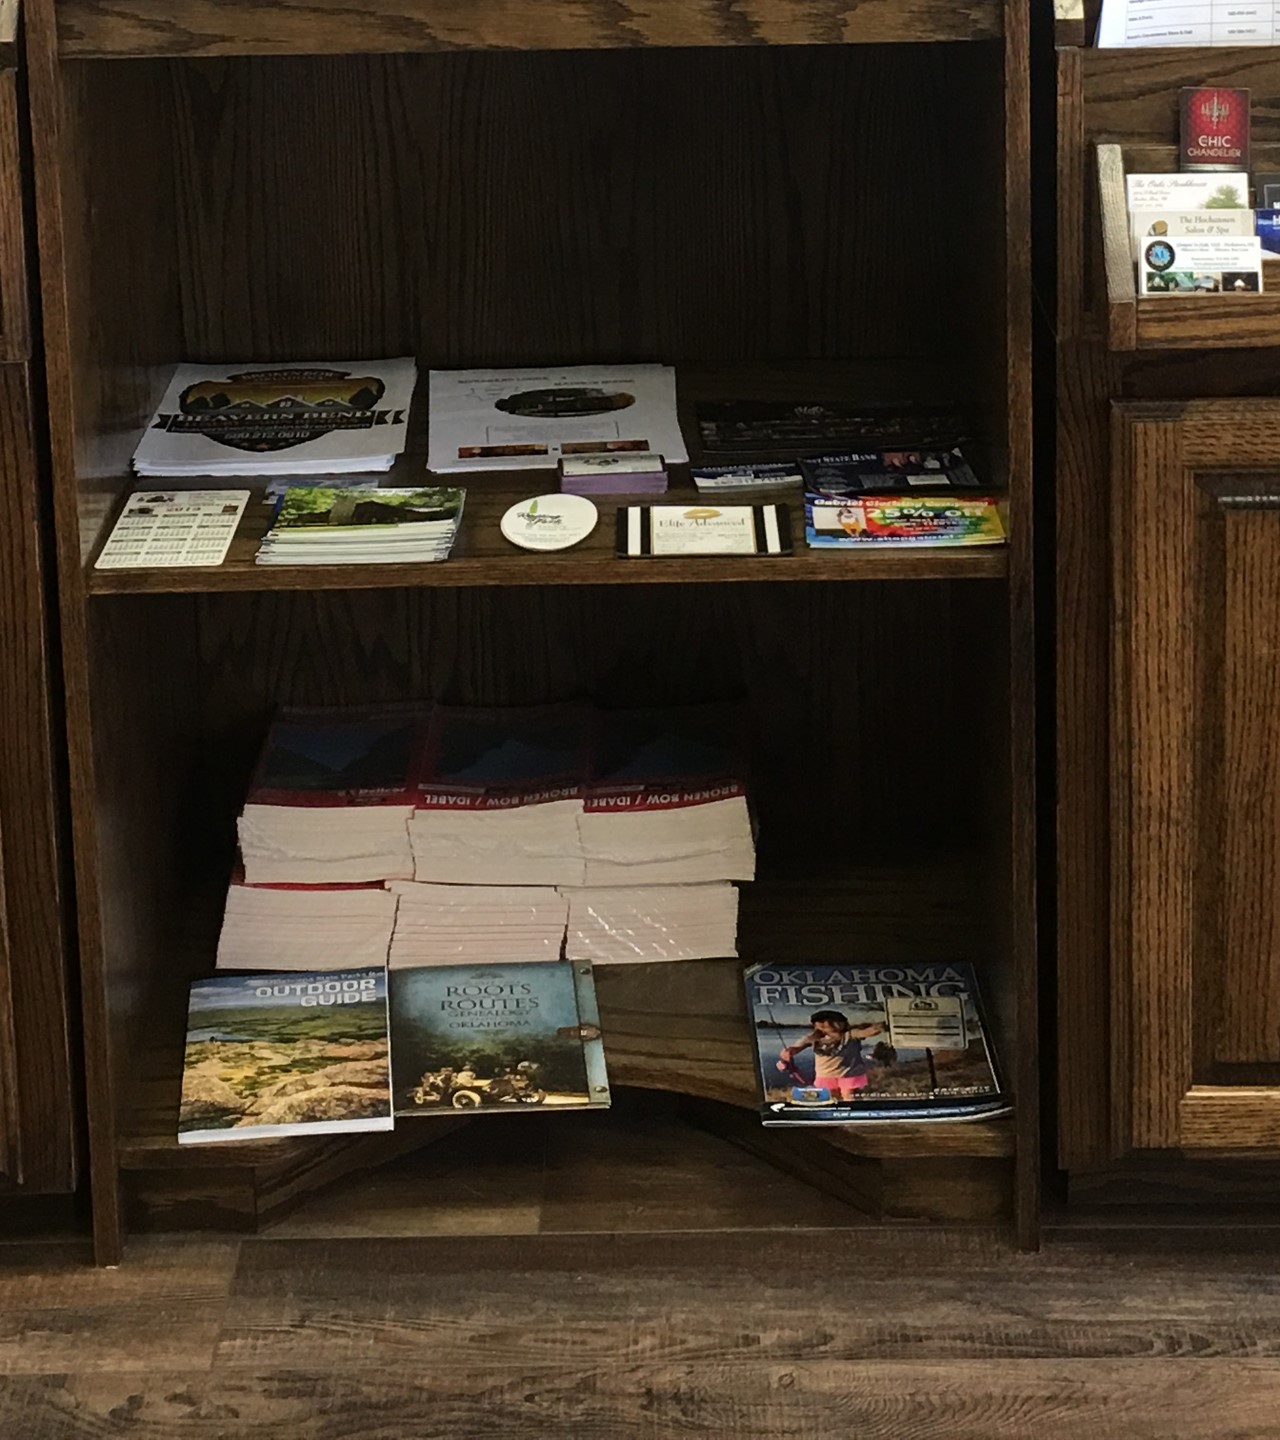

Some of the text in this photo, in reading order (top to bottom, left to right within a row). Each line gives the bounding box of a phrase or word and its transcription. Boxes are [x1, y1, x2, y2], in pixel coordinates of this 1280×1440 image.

[1198, 135, 1231, 148] CHIC
[1187, 148, 1241, 158] CHANDELIER
[753, 968, 965, 985] OKLAHOMA
[255, 979, 376, 999] OUTDOOR
[446, 984, 531, 997] ROOTS
[300, 991, 376, 1007] GUIDE
[441, 997, 539, 1011] ROUTES
[449, 1020, 531, 1028] OKLAHOMA
